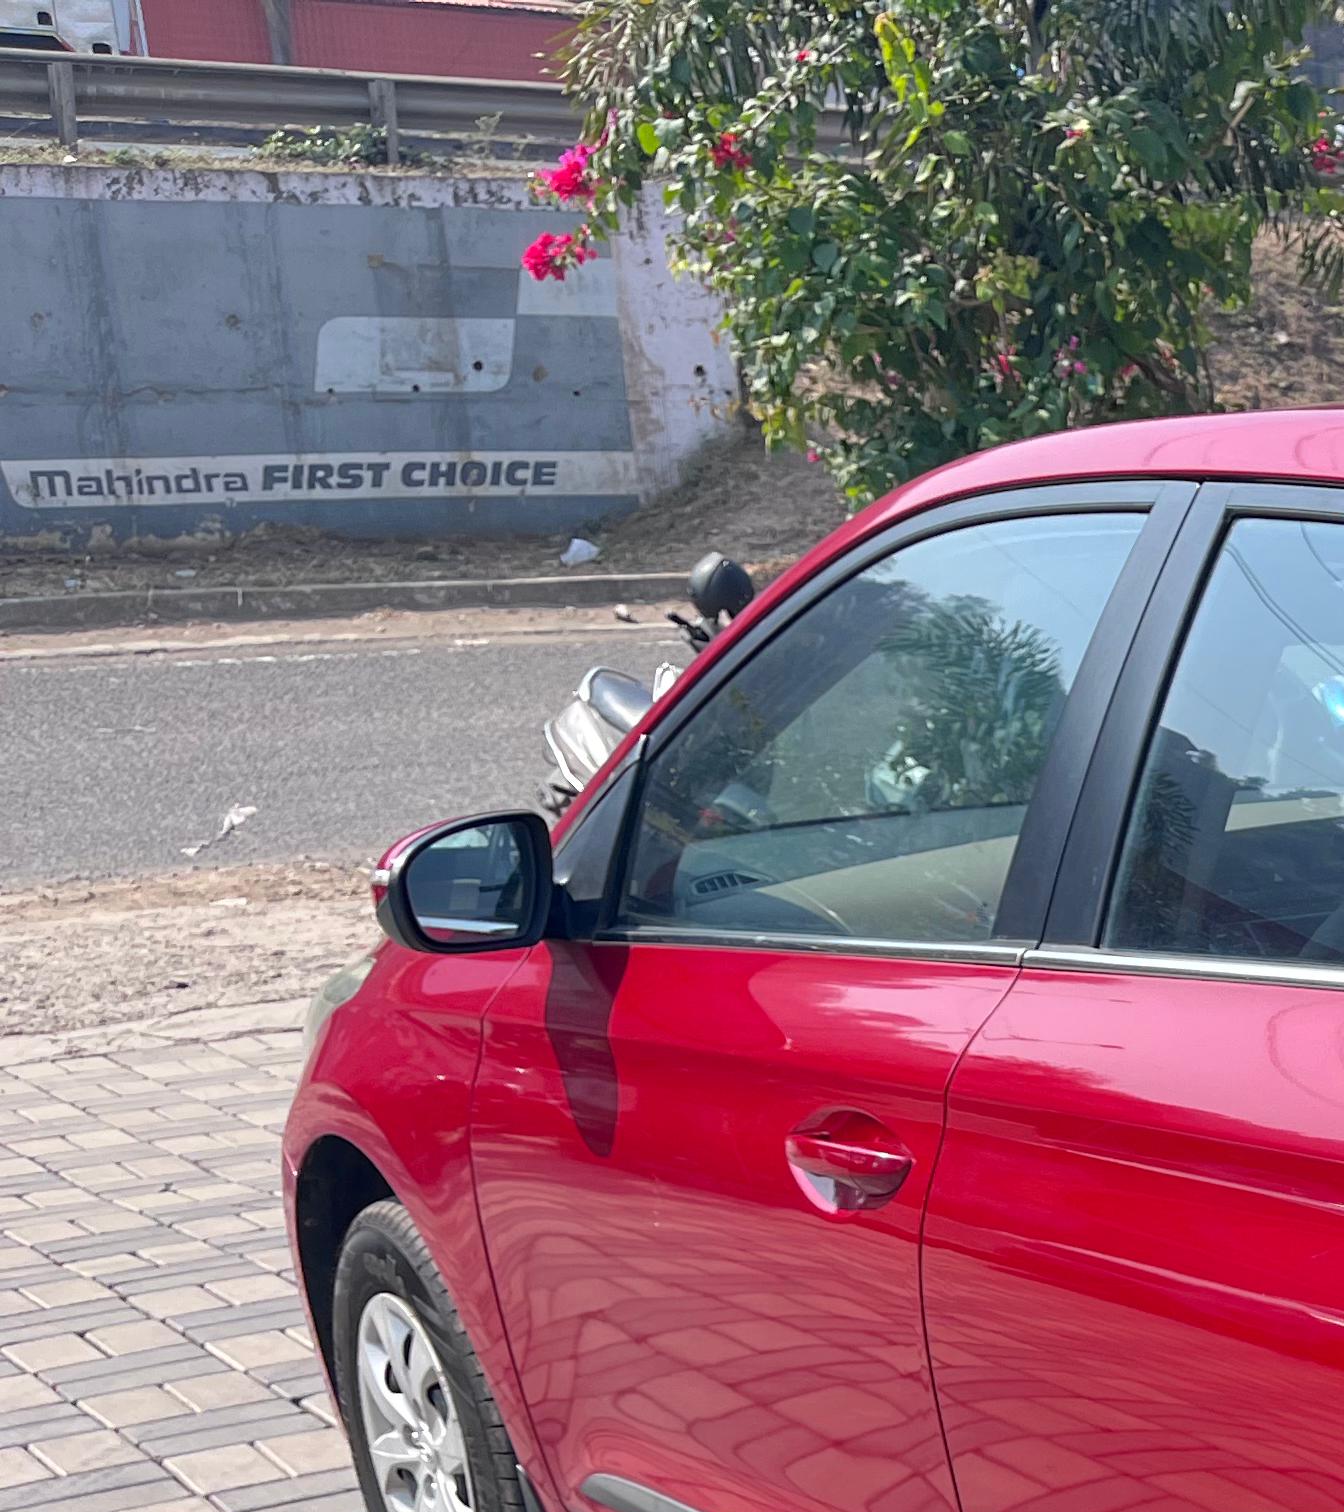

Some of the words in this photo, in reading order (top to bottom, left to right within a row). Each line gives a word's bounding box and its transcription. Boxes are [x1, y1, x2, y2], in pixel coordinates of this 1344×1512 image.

[29, 467, 249, 500] Mahindra
[262, 462, 391, 491] FIRST
[400, 460, 558, 489] CHOICE
